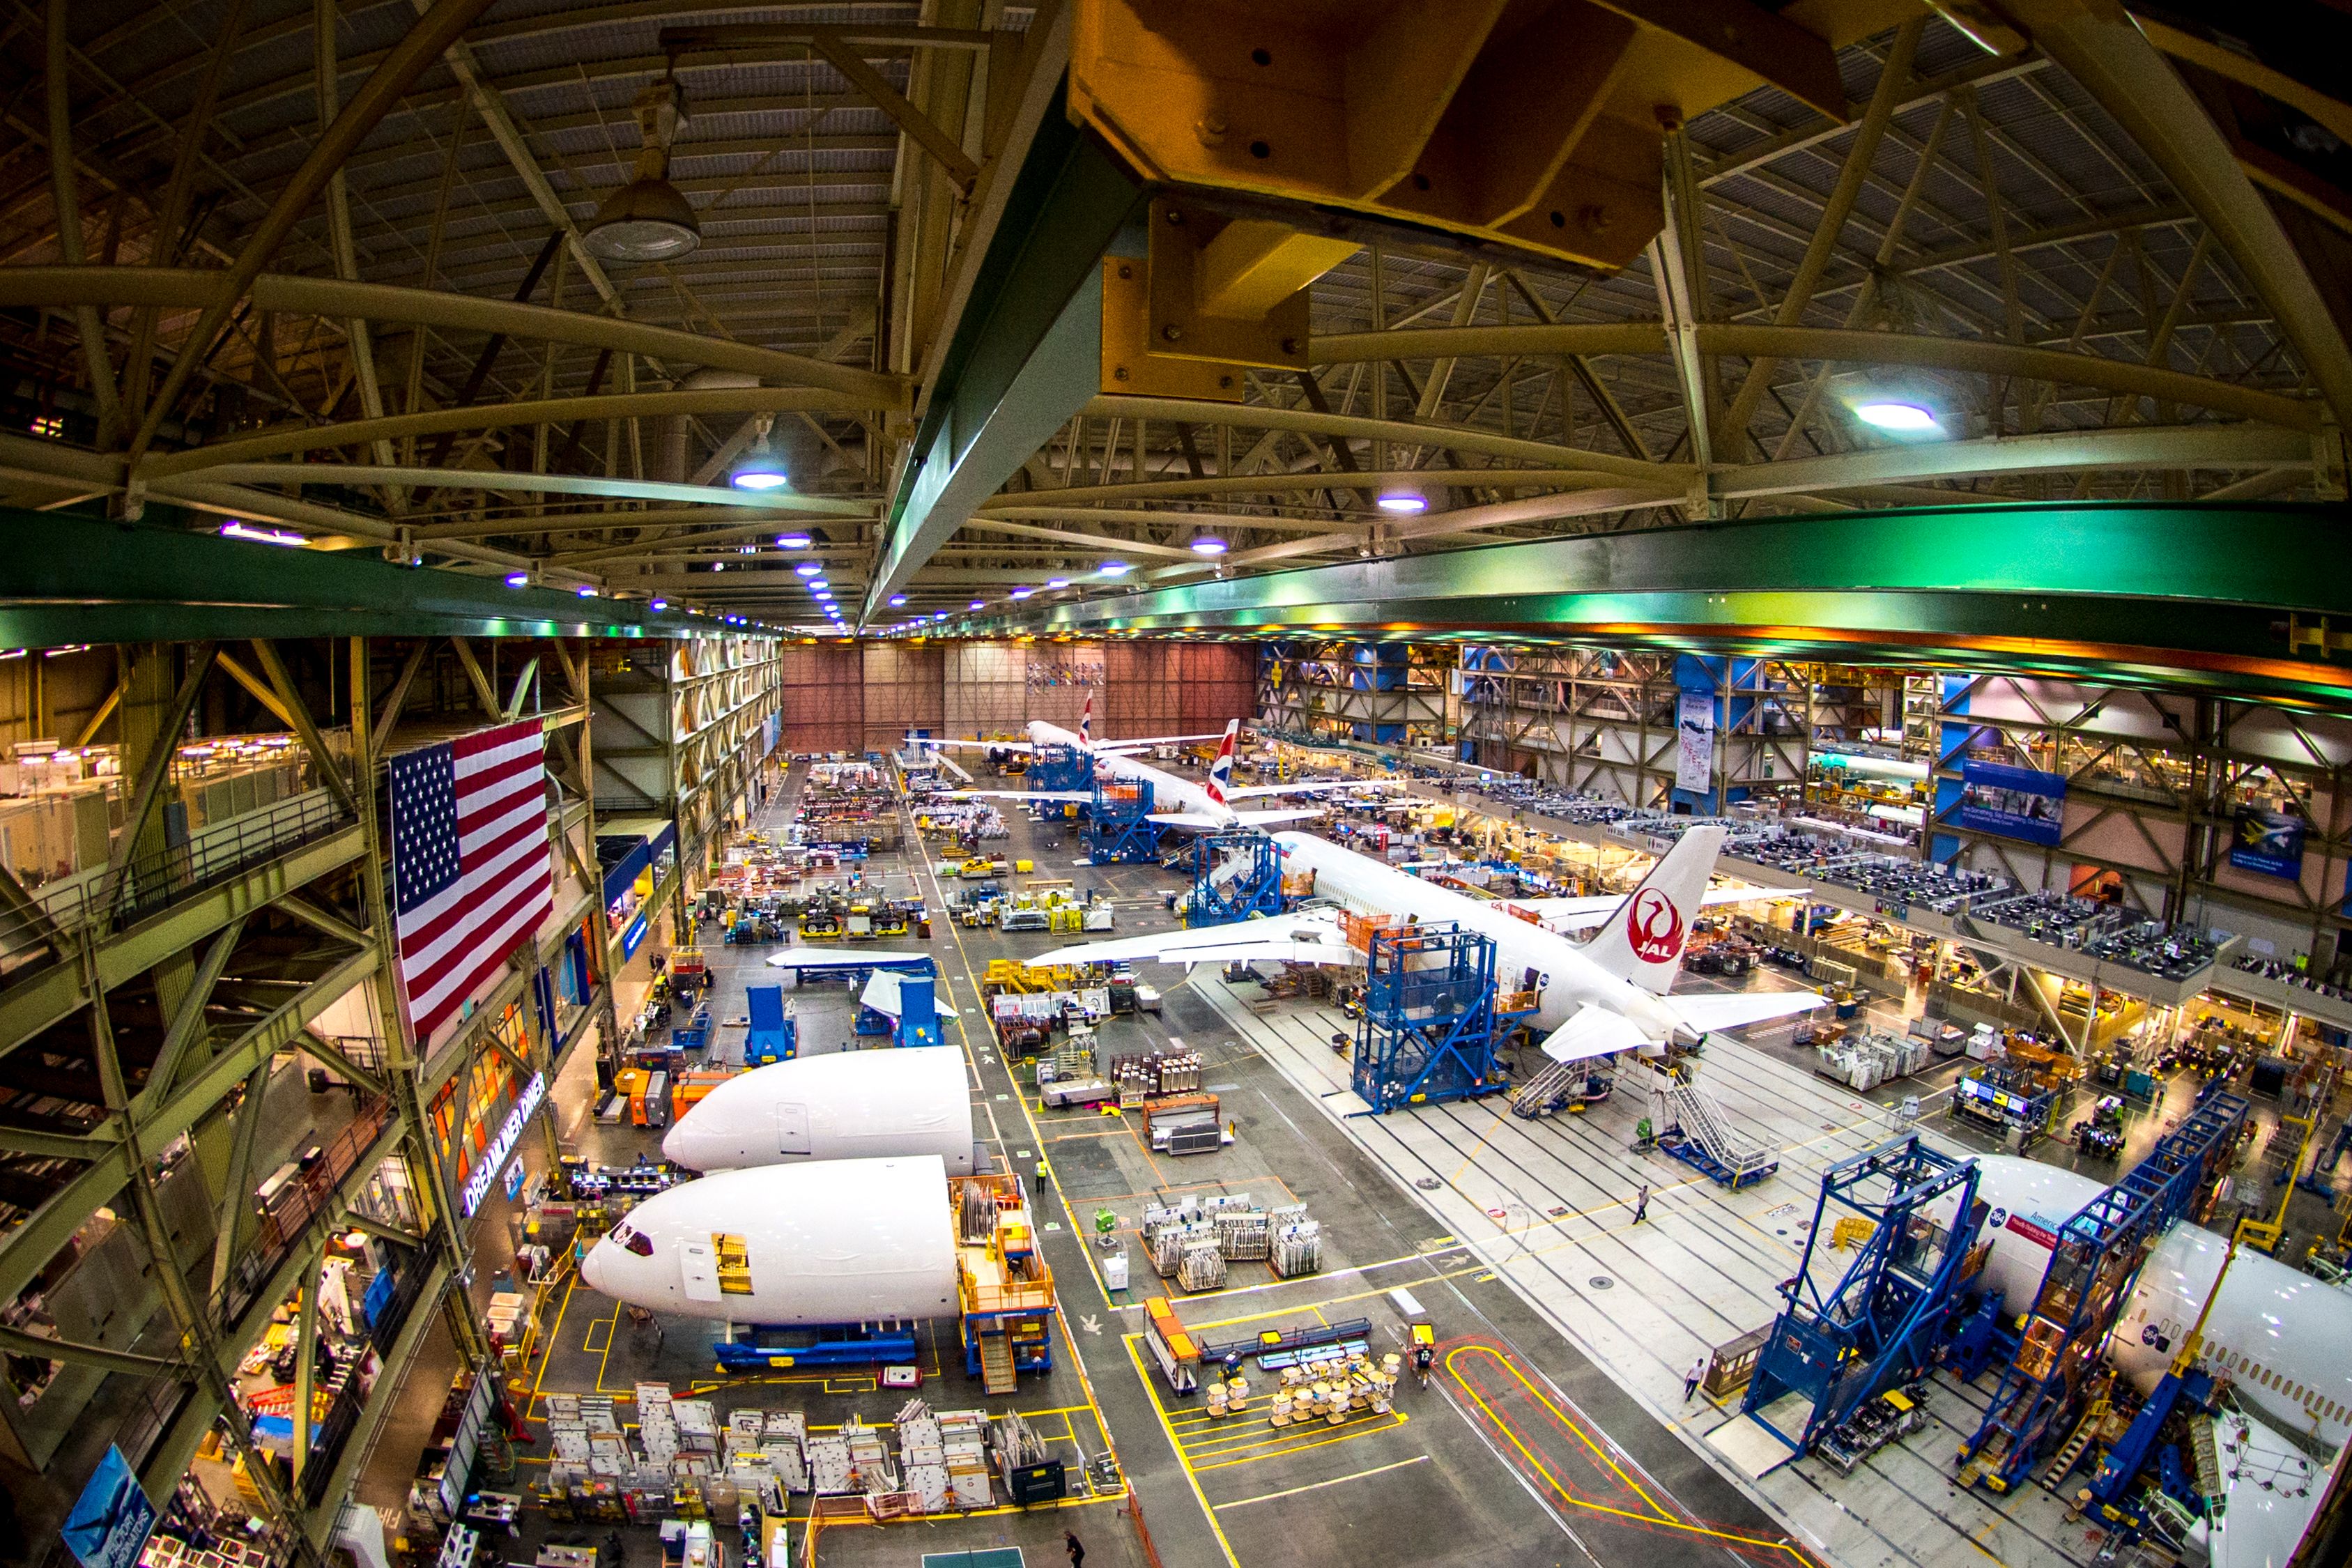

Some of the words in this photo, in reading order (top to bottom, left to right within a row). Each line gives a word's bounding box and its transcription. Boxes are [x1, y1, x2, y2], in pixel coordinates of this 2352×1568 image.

[1638, 940, 1672, 958] JAL
[463, 1109, 523, 1217] DREAMLINER
[518, 1071, 546, 1123] DINER
[1991, 1210, 2005, 1224] 364
[2143, 1328, 2158, 1342] 364
[1421, 1353, 1430, 1361] 12
